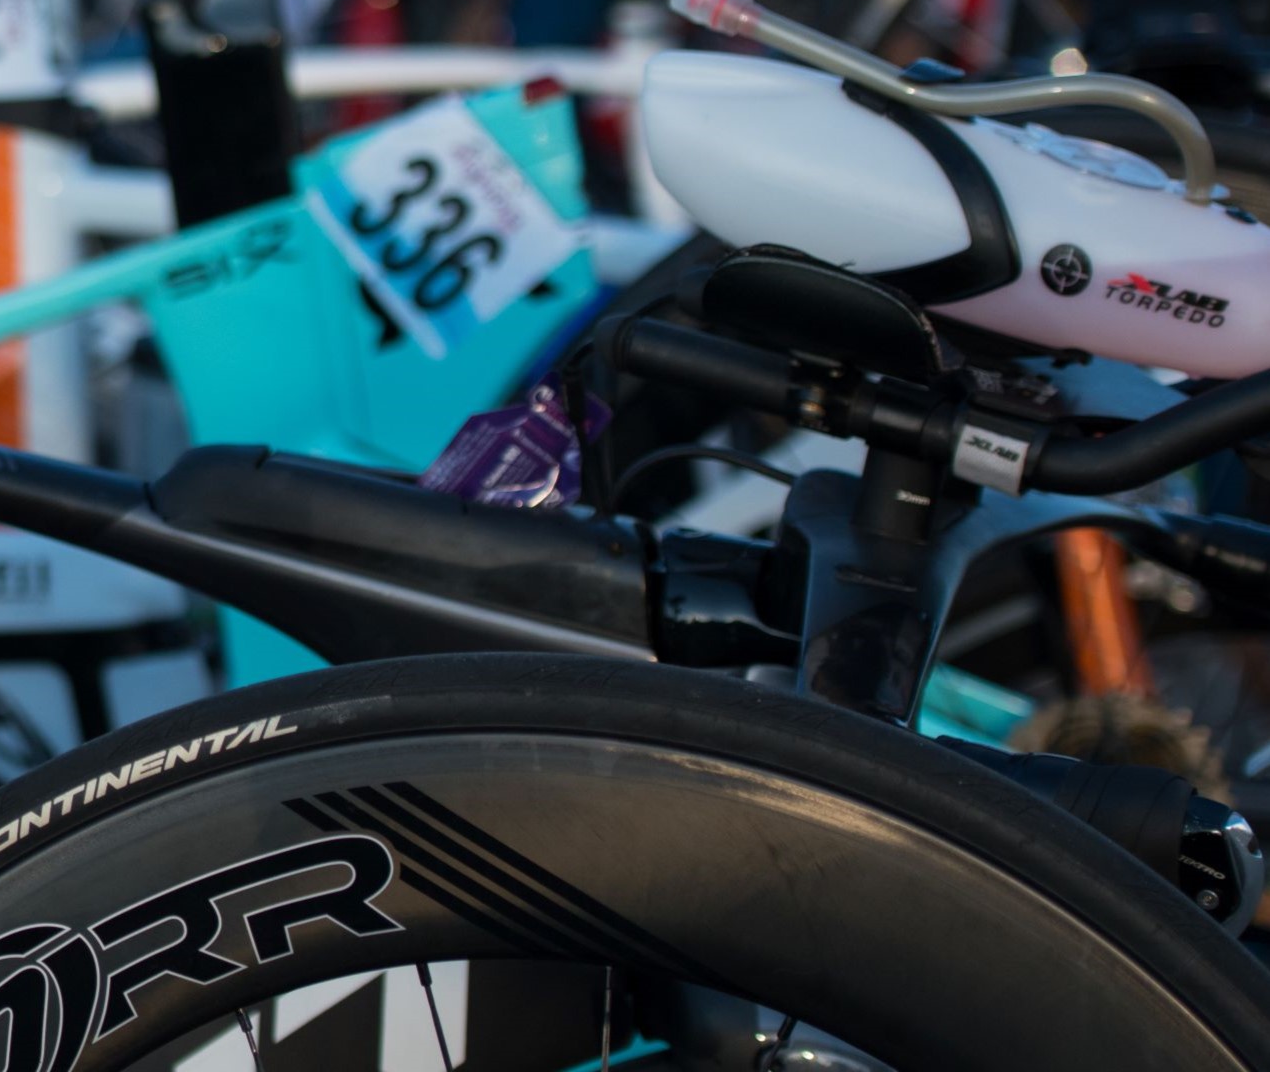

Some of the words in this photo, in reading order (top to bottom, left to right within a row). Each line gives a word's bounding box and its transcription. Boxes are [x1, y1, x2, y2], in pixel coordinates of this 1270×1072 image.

[349, 155, 504, 312] 336
[1104, 285, 1226, 328] TORPEDO
[1106, 271, 1231, 313] XLAB
[1177, 854, 1226, 881] TEKTRO
